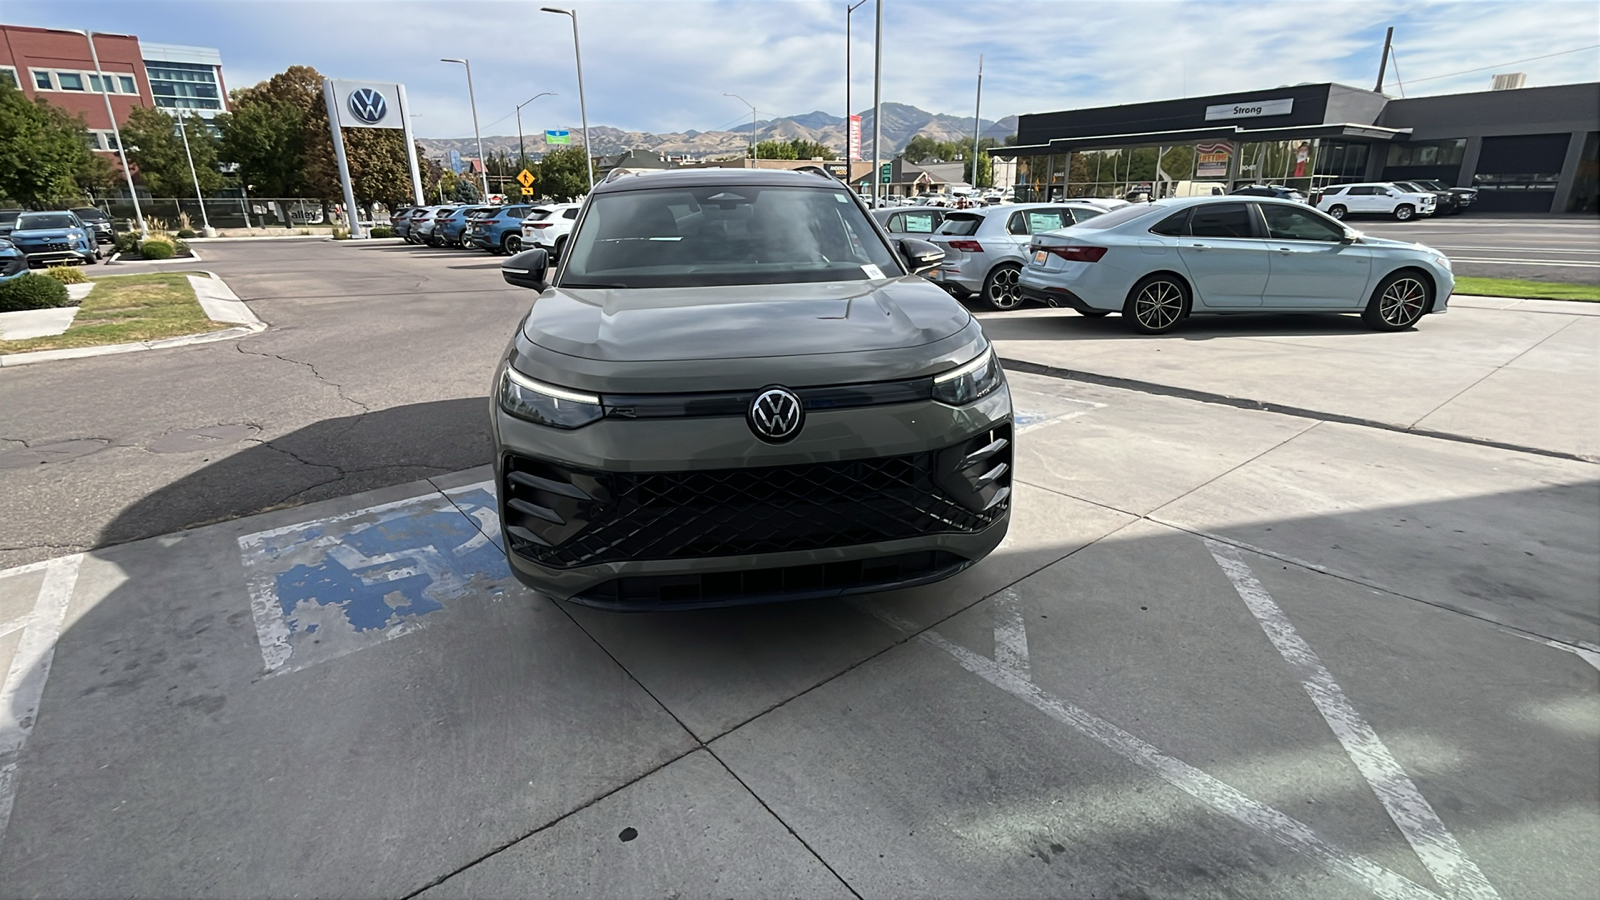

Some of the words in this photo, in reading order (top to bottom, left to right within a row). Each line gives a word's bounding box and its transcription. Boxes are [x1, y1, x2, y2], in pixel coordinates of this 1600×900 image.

[350, 88, 386, 121] VW
[1233, 106, 1262, 114] Strong
[1199, 153, 1228, 162] LIFETIME
[292, 210, 316, 220] alley
[753, 390, 799, 436] VW
